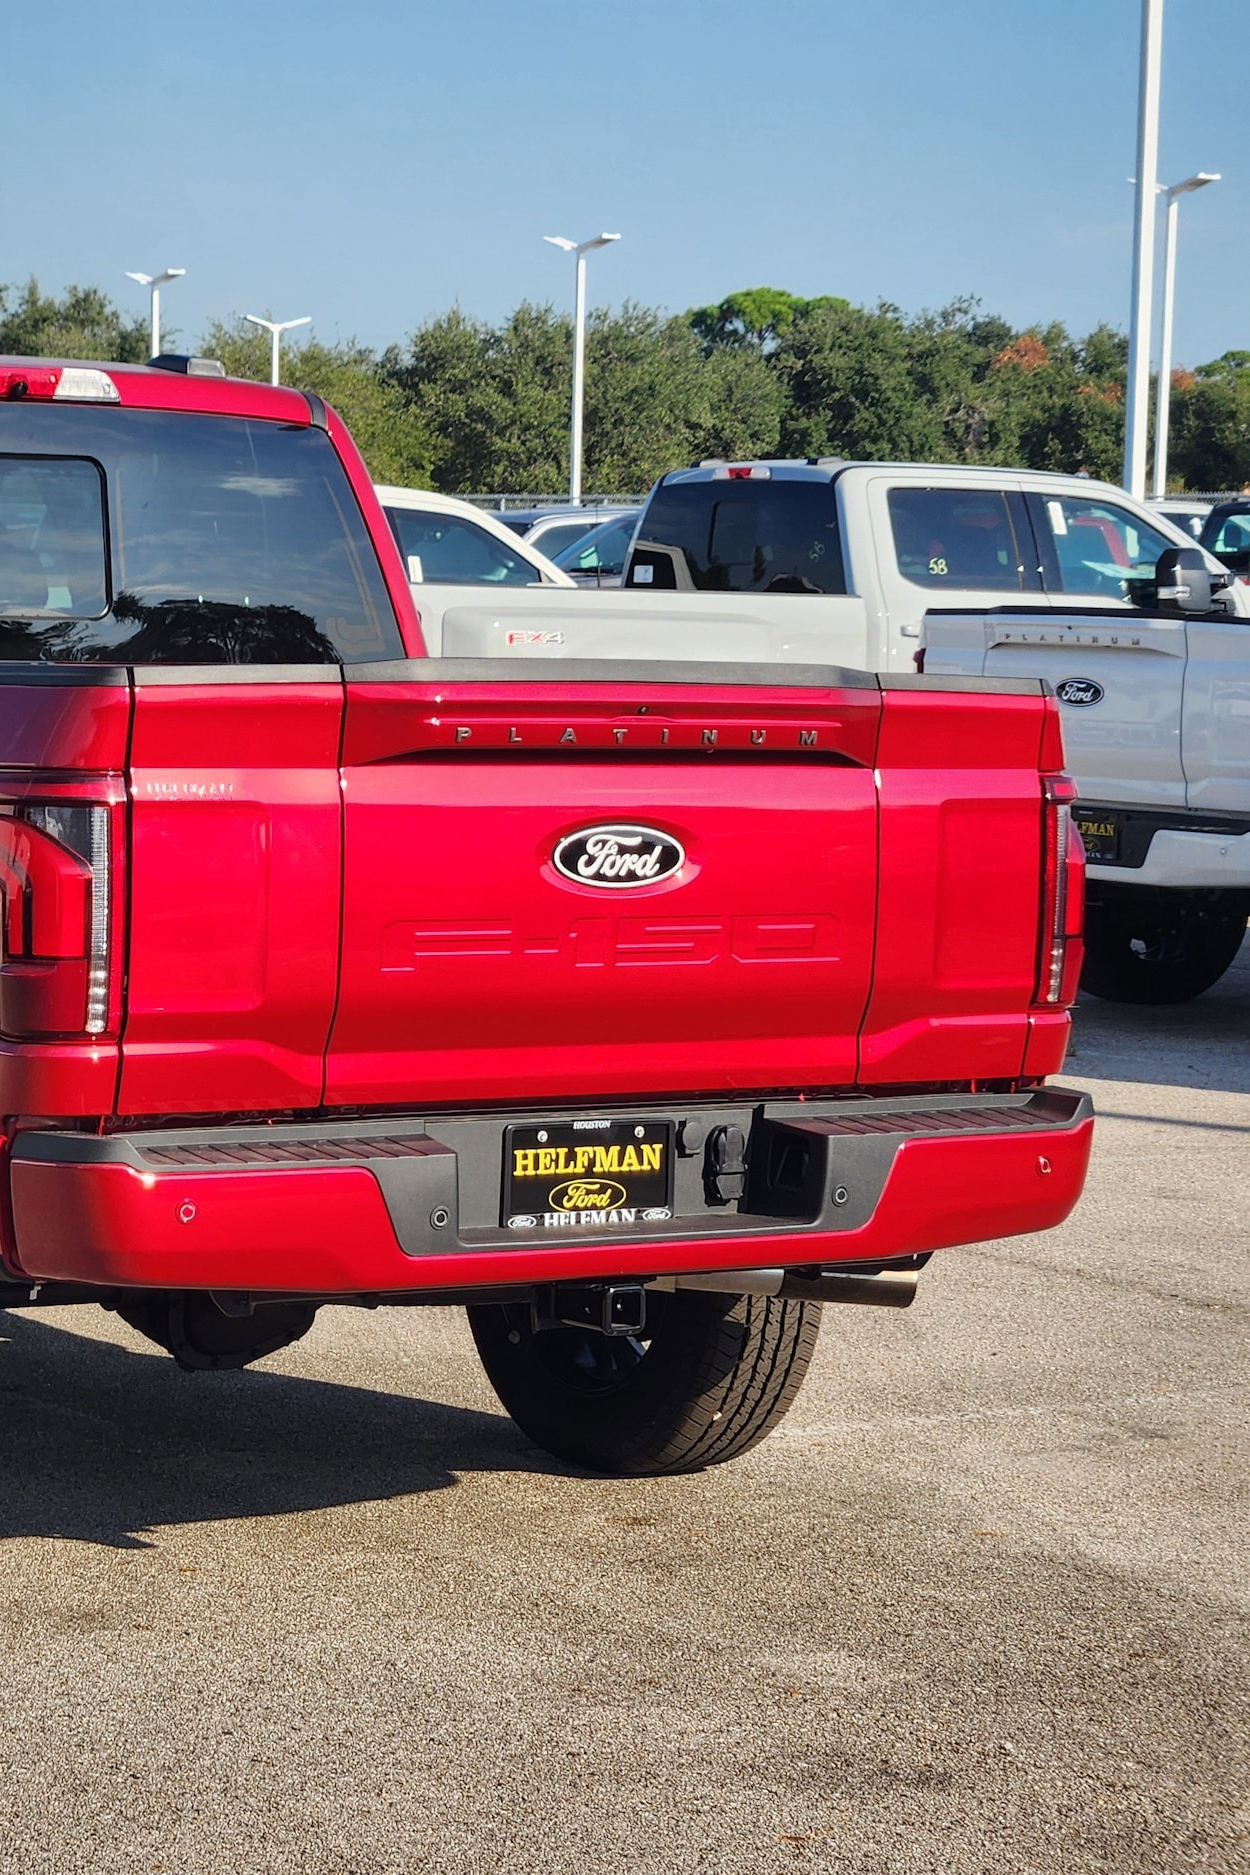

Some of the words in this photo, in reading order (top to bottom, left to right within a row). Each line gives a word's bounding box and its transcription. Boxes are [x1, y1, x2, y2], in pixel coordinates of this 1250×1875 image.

[929, 557, 948, 575] 58
[507, 632, 565, 647] FX4
[1005, 633, 1141, 646] PLATINUM
[1061, 681, 1097, 702] Ford
[454, 726, 819, 747] PLATINUM
[576, 833, 664, 878] Ford
[380, 913, 841, 971] F-150
[573, 1120, 611, 1130] HOUSTON
[513, 1143, 664, 1176] HELFMAN
[562, 1183, 613, 1209] Ford
[543, 1208, 638, 1227] HELFMAN
